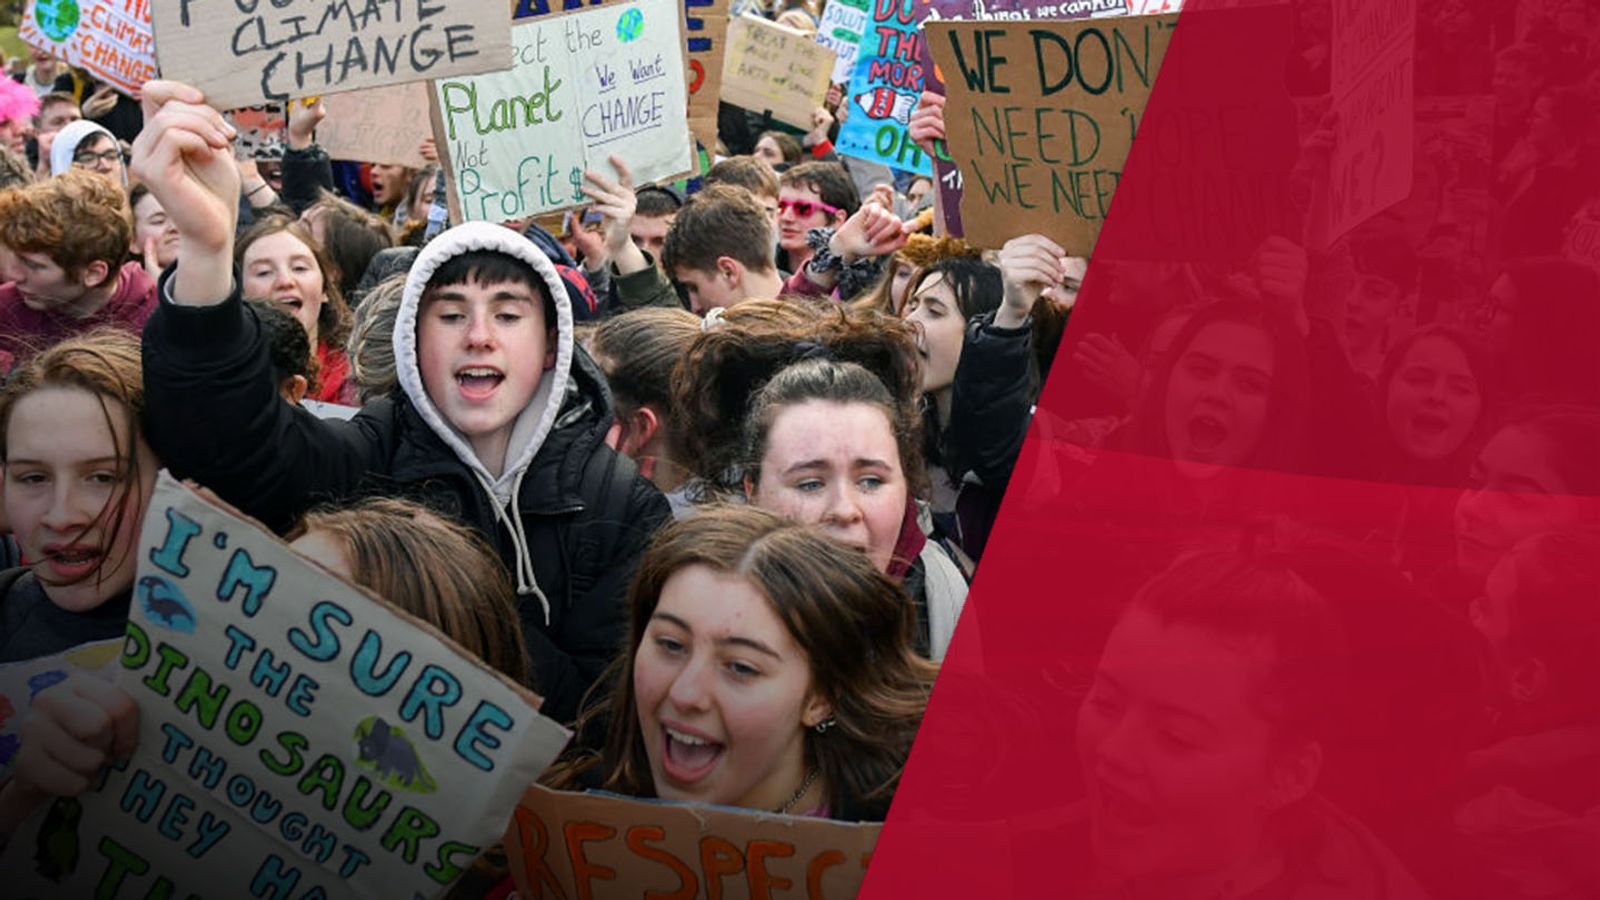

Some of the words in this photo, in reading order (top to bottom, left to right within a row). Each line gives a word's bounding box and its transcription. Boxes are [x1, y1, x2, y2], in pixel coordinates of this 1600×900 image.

[91, 4, 155, 58] CLIMAT
[231, 0, 446, 56] CLIMATE
[565, 19, 603, 53] the
[262, 25, 480, 100] CHANGE
[596, 64, 617, 94] We
[630, 53, 667, 84] Want
[868, 60, 928, 92] MOR
[949, 28, 1011, 94] WE
[442, 65, 562, 141] Planet
[581, 91, 665, 139] CHANGE
[456, 139, 489, 169] Not
[971, 107, 1101, 168] NEED
[460, 154, 564, 221] Profit
[971, 159, 1036, 209] WE
[149, 506, 277, 618] I'M
[287, 600, 515, 773] SURE
[222, 625, 320, 718] THE
[119, 622, 480, 886] DINOSAURS
[161, 723, 371, 880] THOUGHT
[514, 806, 872, 900] RESPEC
